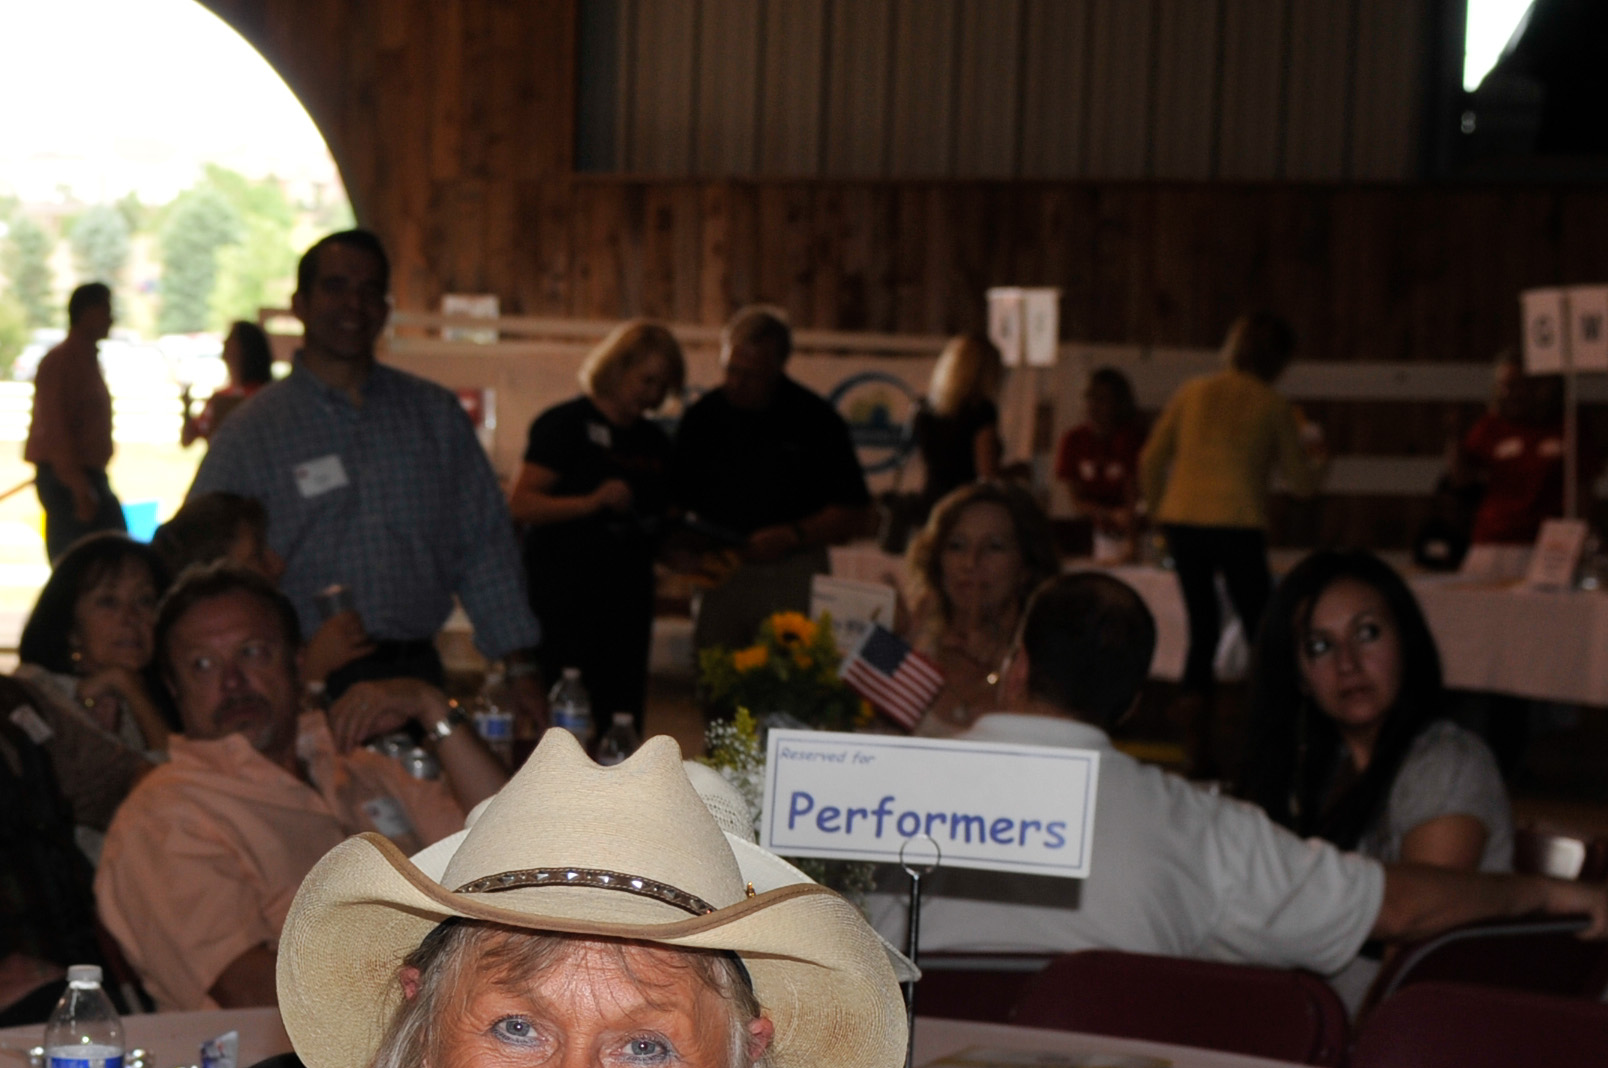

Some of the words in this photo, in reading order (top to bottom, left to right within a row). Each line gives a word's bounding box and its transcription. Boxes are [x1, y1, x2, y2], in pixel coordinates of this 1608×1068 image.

[779, 749, 846, 764] Reserved
[852, 752, 876, 765] for
[788, 791, 1067, 850] Performers
